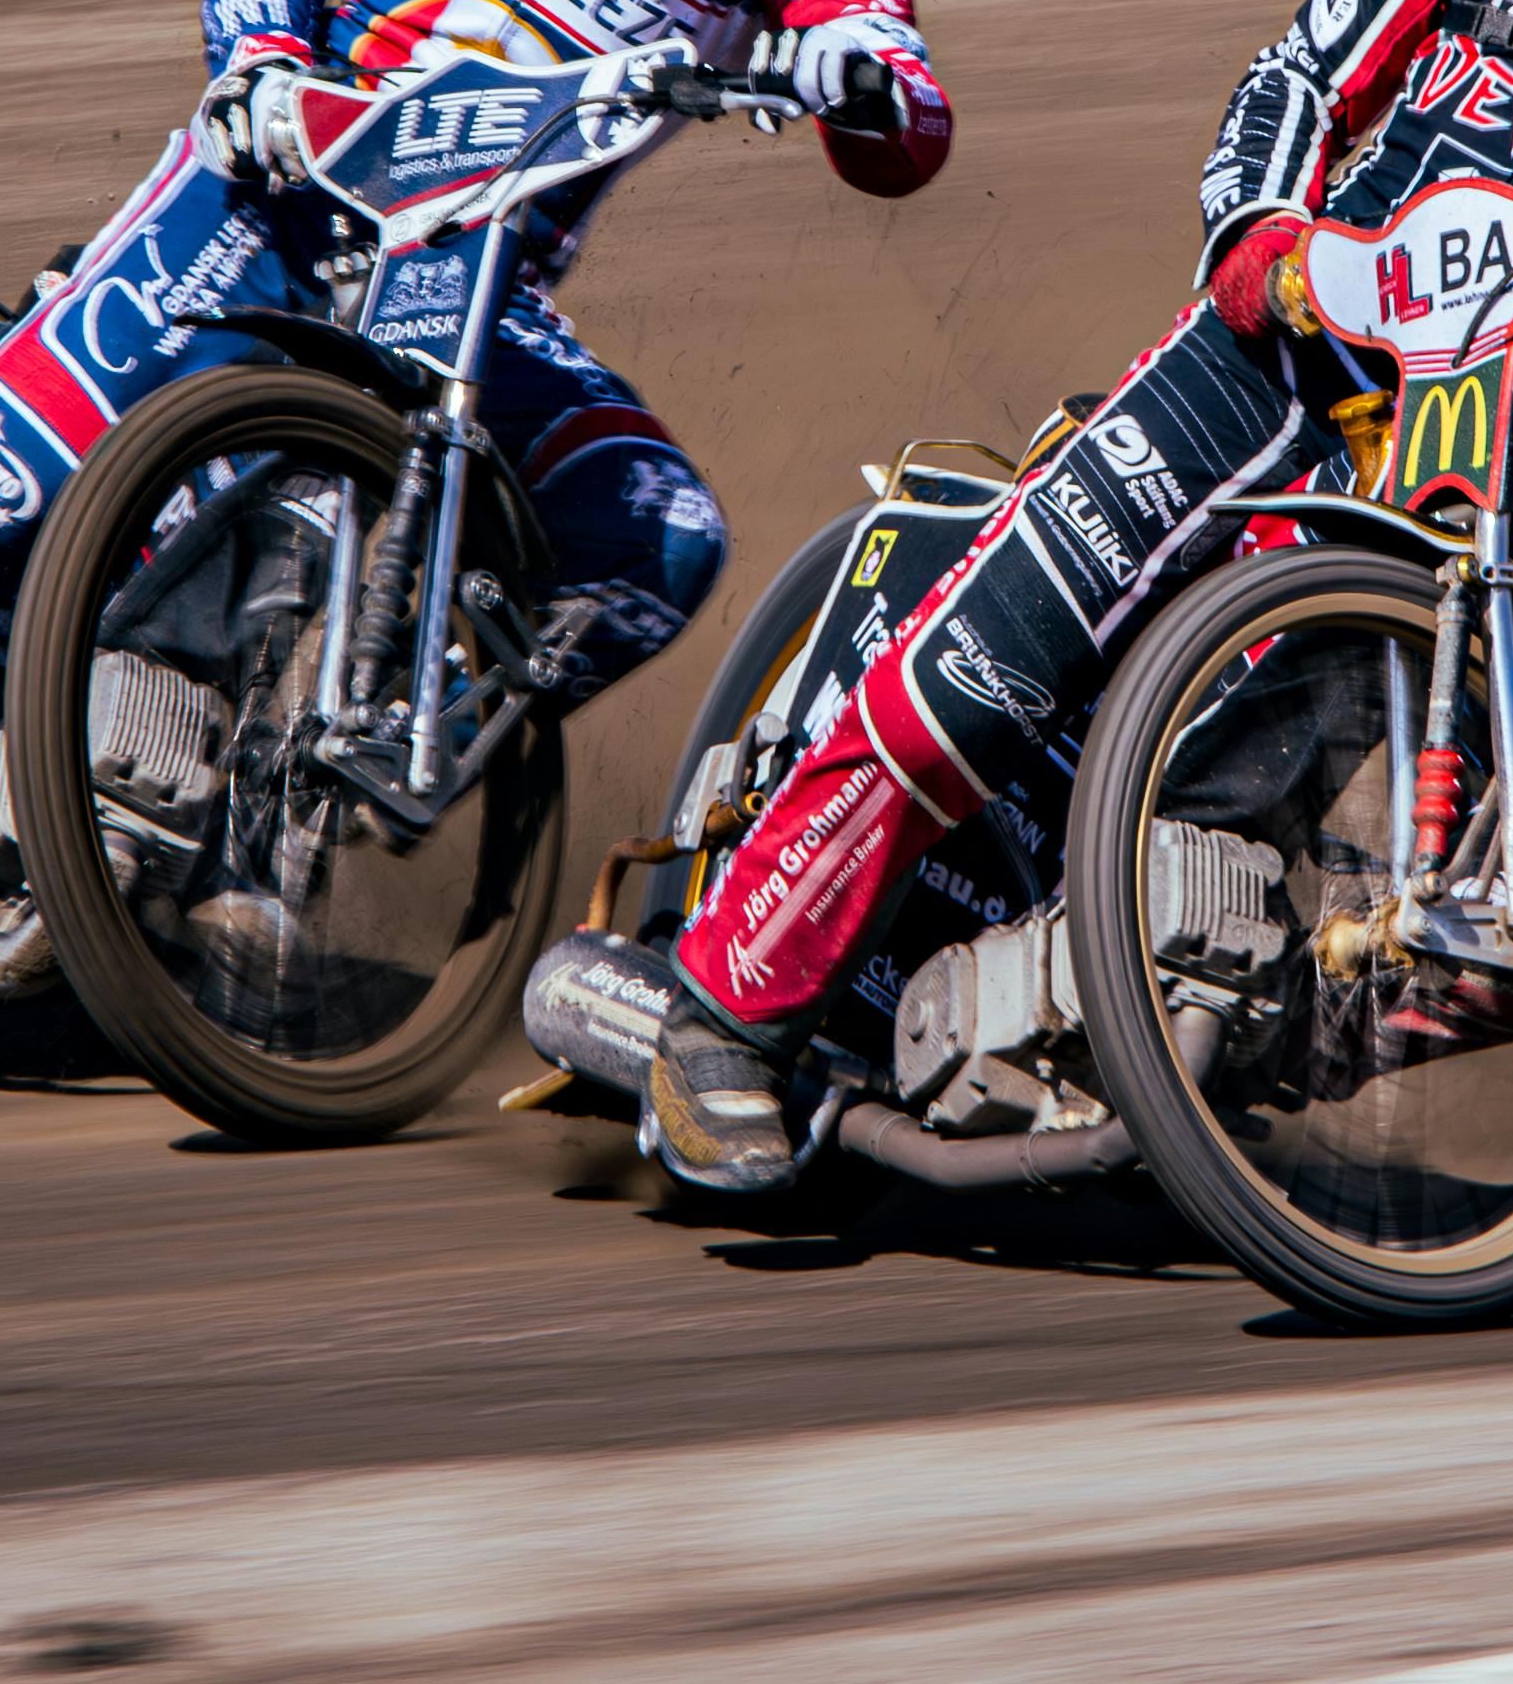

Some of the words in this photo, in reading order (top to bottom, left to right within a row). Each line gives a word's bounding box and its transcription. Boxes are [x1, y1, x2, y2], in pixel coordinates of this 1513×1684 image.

[392, 87, 545, 159] LTE
[389, 156, 440, 181] logistics
[1123, 478, 1152, 519] Sport
[1141, 474, 1177, 530] Stiftung
[1158, 470, 1189, 508] ADAC
[941, 616, 1049, 750] BRUNKHORST
[743, 876, 790, 933] Jörg
[778, 761, 880, 876] Grohmann
[804, 859, 861, 926] Insurance
[851, 824, 886, 870] Broker
